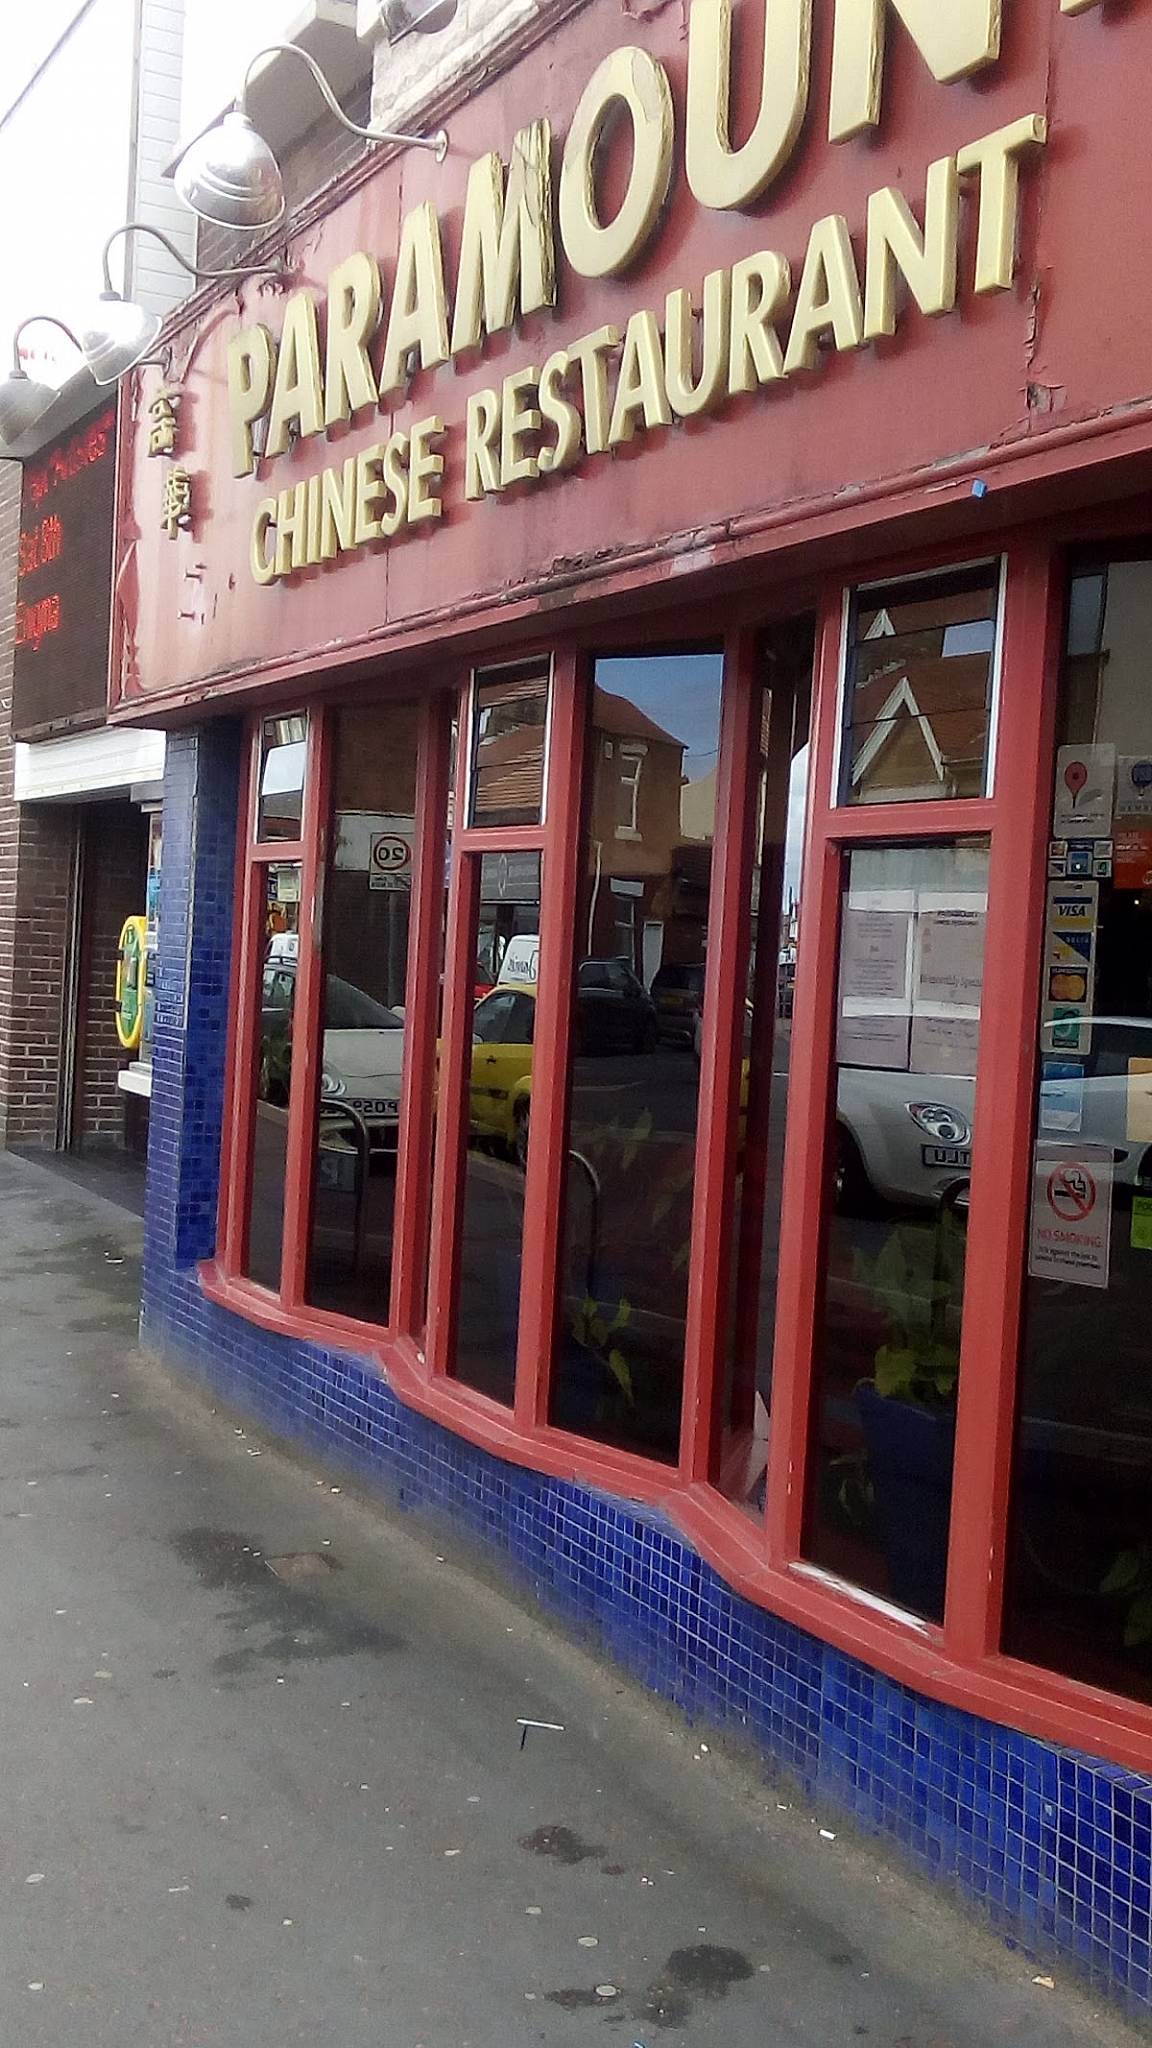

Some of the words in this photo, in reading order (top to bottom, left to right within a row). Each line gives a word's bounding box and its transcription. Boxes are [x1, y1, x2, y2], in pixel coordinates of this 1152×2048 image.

[228, 0, 1113, 479] PARAMOUN
[250, 414, 445, 586] CHINESE
[465, 113, 1048, 502] RESTAURANT
[1059, 905, 1086, 917] VISA
[1054, 1229, 1104, 1248] SMOKING
